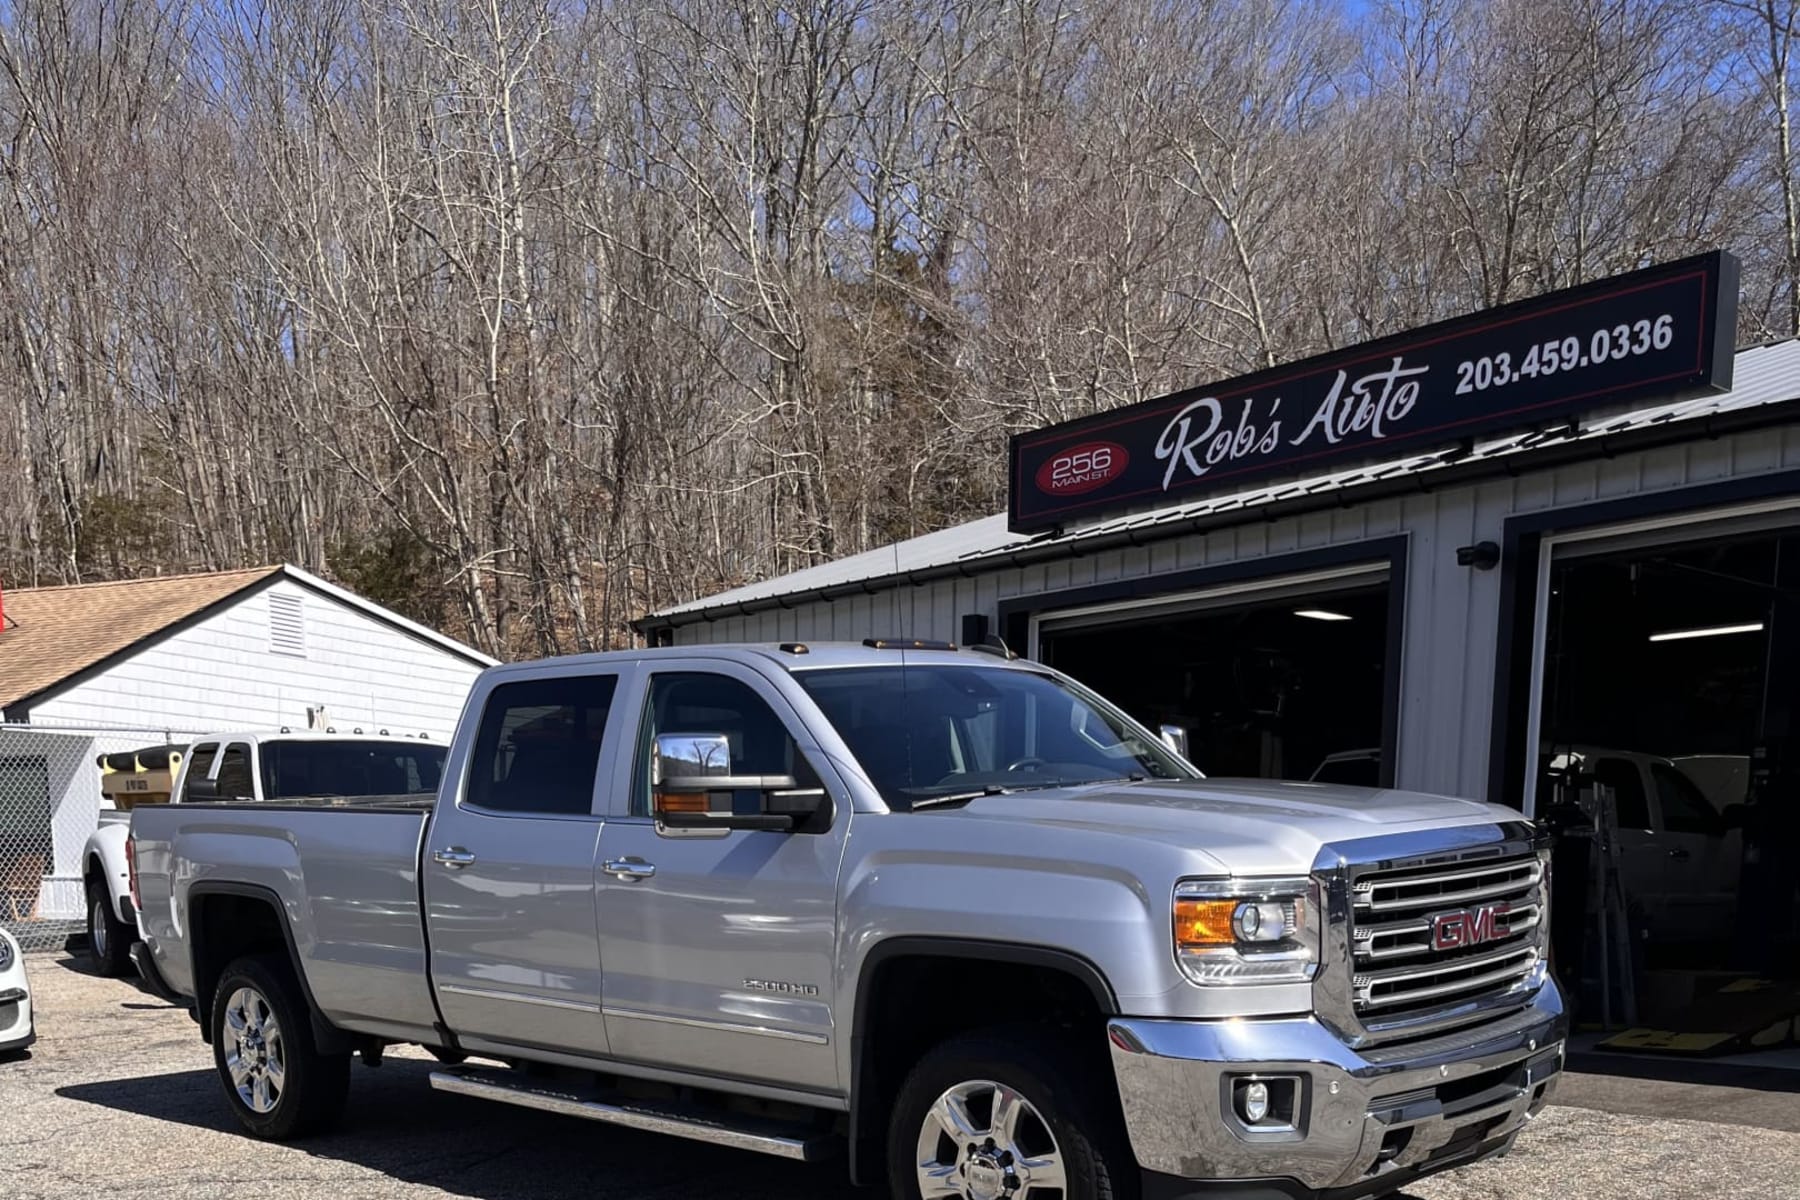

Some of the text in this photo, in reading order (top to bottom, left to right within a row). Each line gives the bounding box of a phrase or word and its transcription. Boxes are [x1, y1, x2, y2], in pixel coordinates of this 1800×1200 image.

[1155, 314, 1673, 491] Rob's Auto 203.459.0336
[1052, 448, 1111, 479] 256
[1052, 474, 1090, 488] MAIN
[1433, 905, 1511, 951] GMC
